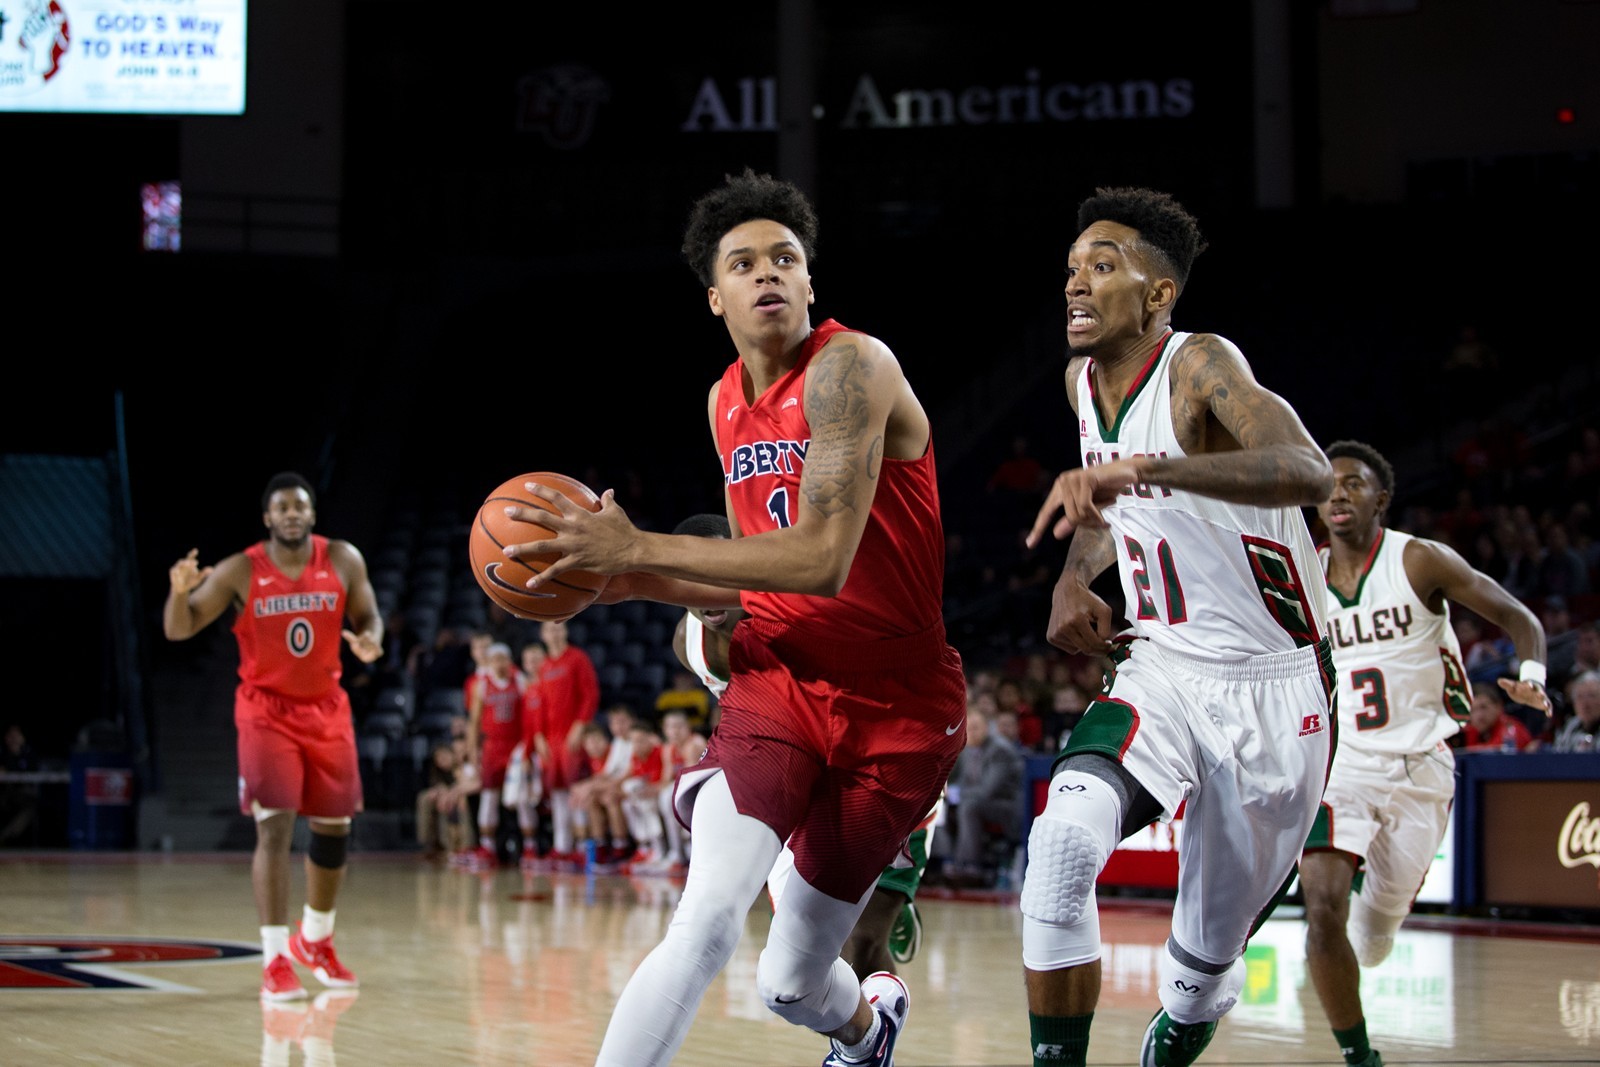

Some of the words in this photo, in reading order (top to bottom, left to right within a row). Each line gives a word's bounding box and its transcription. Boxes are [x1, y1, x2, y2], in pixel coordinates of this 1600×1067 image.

[95, 14, 167, 33] GOD'S
[178, 16, 223, 37] Way
[81, 39, 111, 58] TO
[681, 76, 777, 132] All
[840, 68, 1195, 129] Americans
[766, 487, 792, 528] 1
[1123, 534, 1188, 625] 21
[253, 592, 339, 618] LIBERTY
[286, 617, 315, 658] 0
[1351, 667, 1390, 732] 3
